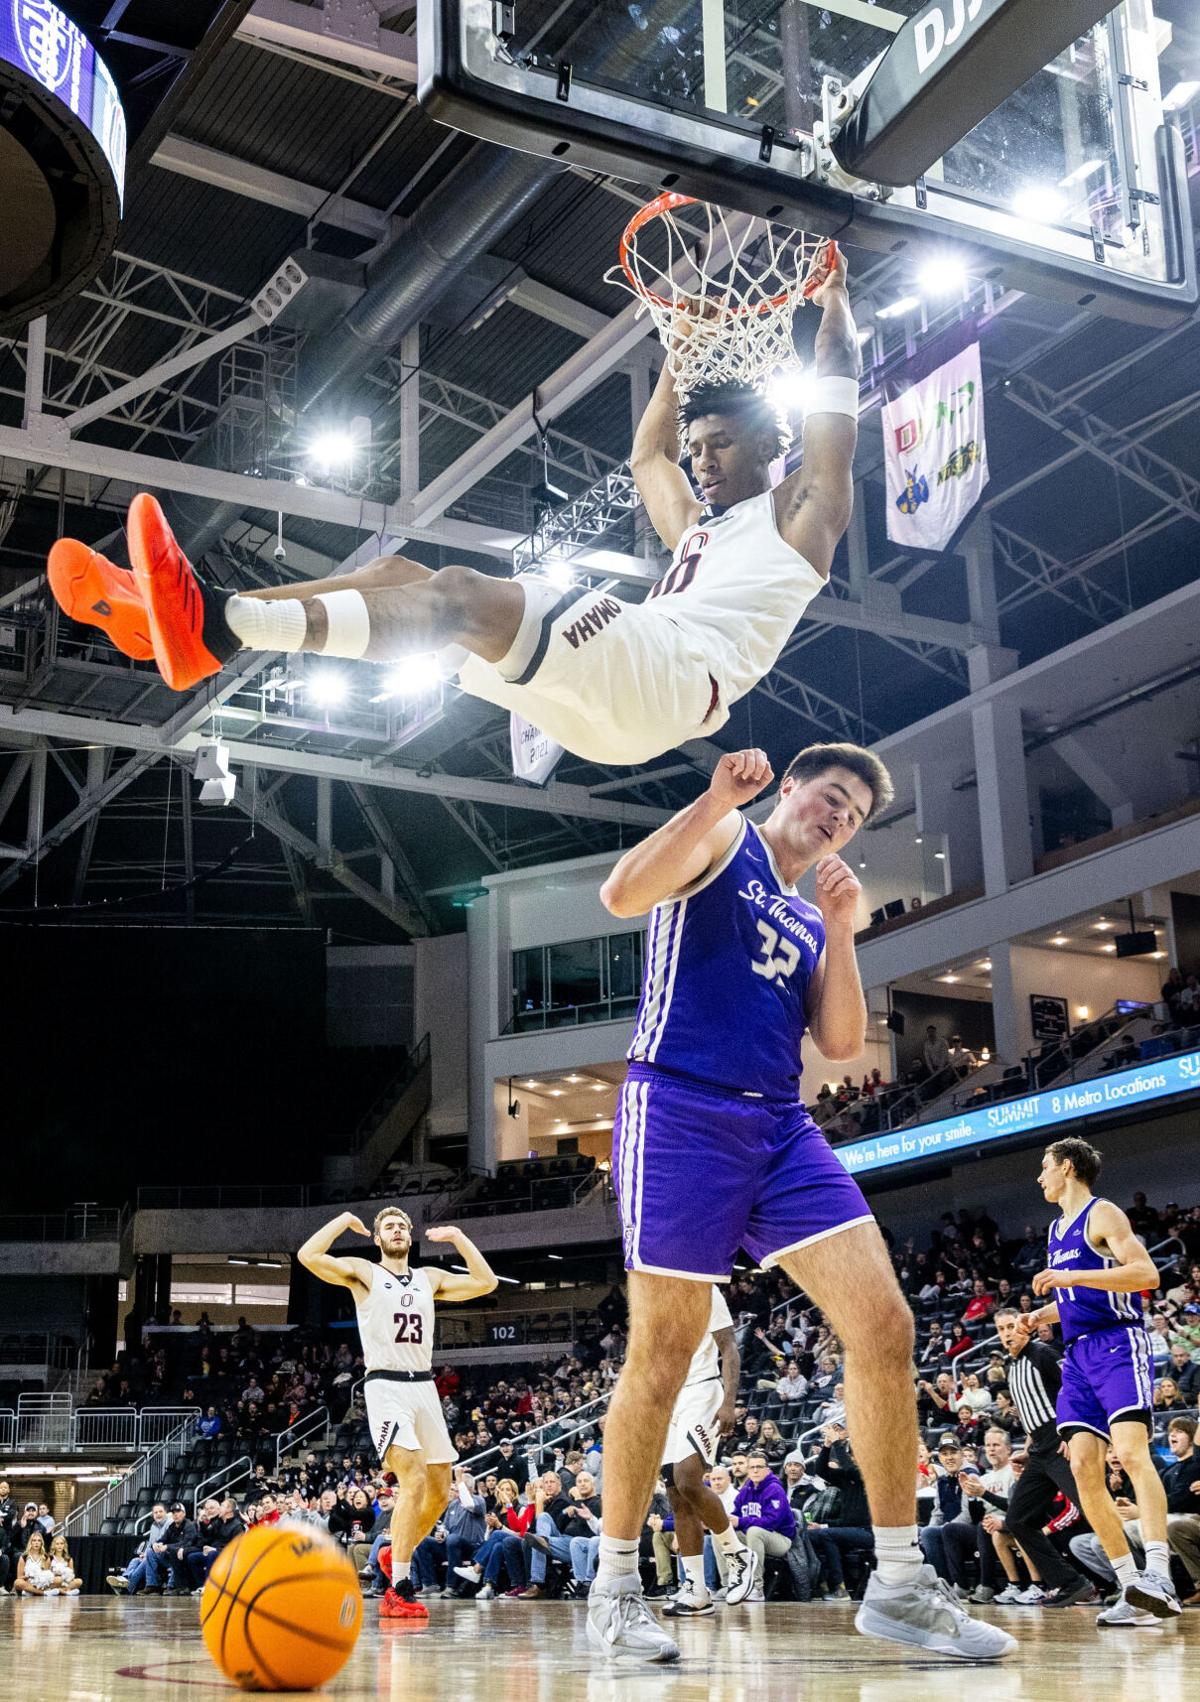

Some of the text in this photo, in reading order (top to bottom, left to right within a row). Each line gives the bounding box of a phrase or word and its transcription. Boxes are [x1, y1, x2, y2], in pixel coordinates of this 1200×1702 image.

[561, 598, 622, 650] OMAHA
[738, 879, 818, 954] St. Thomas
[844, 1147, 875, 1166] We're
[877, 1142, 899, 1159] here
[901, 1135, 916, 1153] for
[917, 1132, 943, 1154] your
[945, 1119, 976, 1142] smile.
[987, 1097, 1040, 1129] SUMMIT
[1051, 1098, 1060, 1115] 8
[1064, 1090, 1103, 1112] Metro
[1105, 1073, 1167, 1102] Locations
[393, 1312, 423, 1345] 23
[491, 1326, 517, 1340] 102
[376, 1420, 392, 1454] OMAHA
